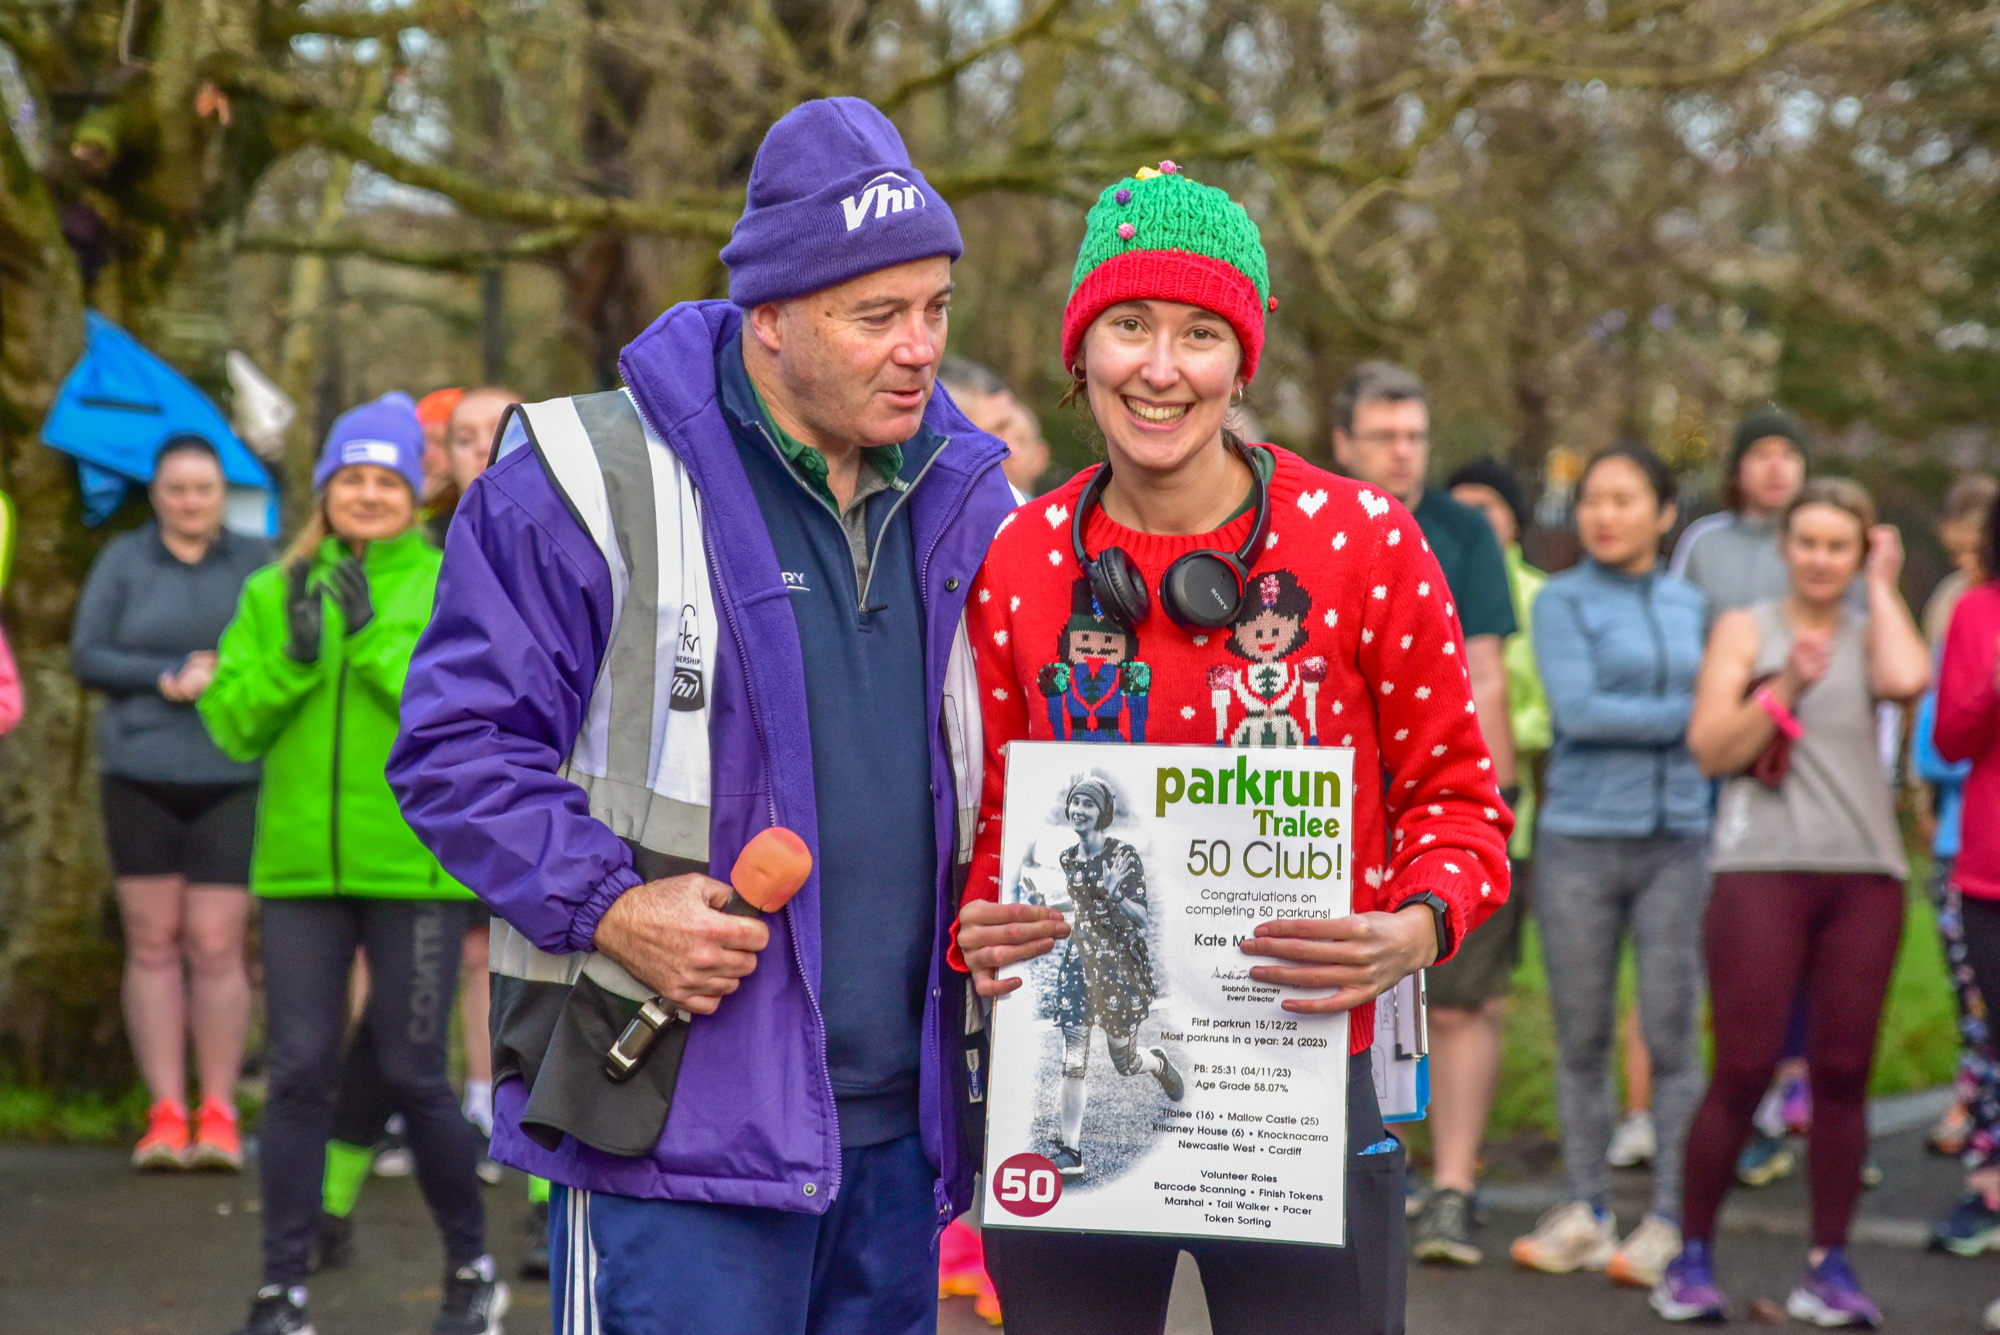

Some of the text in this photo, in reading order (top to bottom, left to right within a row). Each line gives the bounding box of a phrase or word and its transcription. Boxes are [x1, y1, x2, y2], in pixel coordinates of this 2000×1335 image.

[840, 182, 915, 231] Vhi
[1210, 587, 1228, 610] SONY
[1155, 755, 1341, 818] parkrun
[1252, 809, 1340, 838] Tralee
[1186, 839, 1342, 880] 50 Club!
[1200, 889, 1317, 903] Congratulations on
[1185, 905, 1331, 919] completing 50 parkruns!
[1194, 933, 1227, 947] Kate
[1221, 985, 1250, 993] Siobhán
[1252, 986, 1281, 995] Kearney
[1226, 994, 1275, 1003] Event Director
[1191, 1017, 1298, 1031] First parkrun 15/12/22
[1160, 1032, 1327, 1048] Most parkruns in a year: 24 (2023)
[1193, 1064, 1292, 1078] PB: 25:31 (04/11/23)
[1195, 1080, 1289, 1093] Age Grade 58.07%
[1162, 1108, 1320, 1127] Tralee (16) Mallow Castle (25)
[1152, 1123, 1329, 1142] Killarney House (6) Knocknacarra
[1178, 1140, 1302, 1156] Newcastle West Cardiff
[1200, 1169, 1278, 1184] Volunteer Roles
[1001, 1167, 1055, 1204] 50
[1154, 1181, 1323, 1202] Barcode Scanning Finish Tokens
[1164, 1196, 1312, 1215] Marshal Tail Walker Pacer
[1204, 1213, 1272, 1229] Token Sorting
